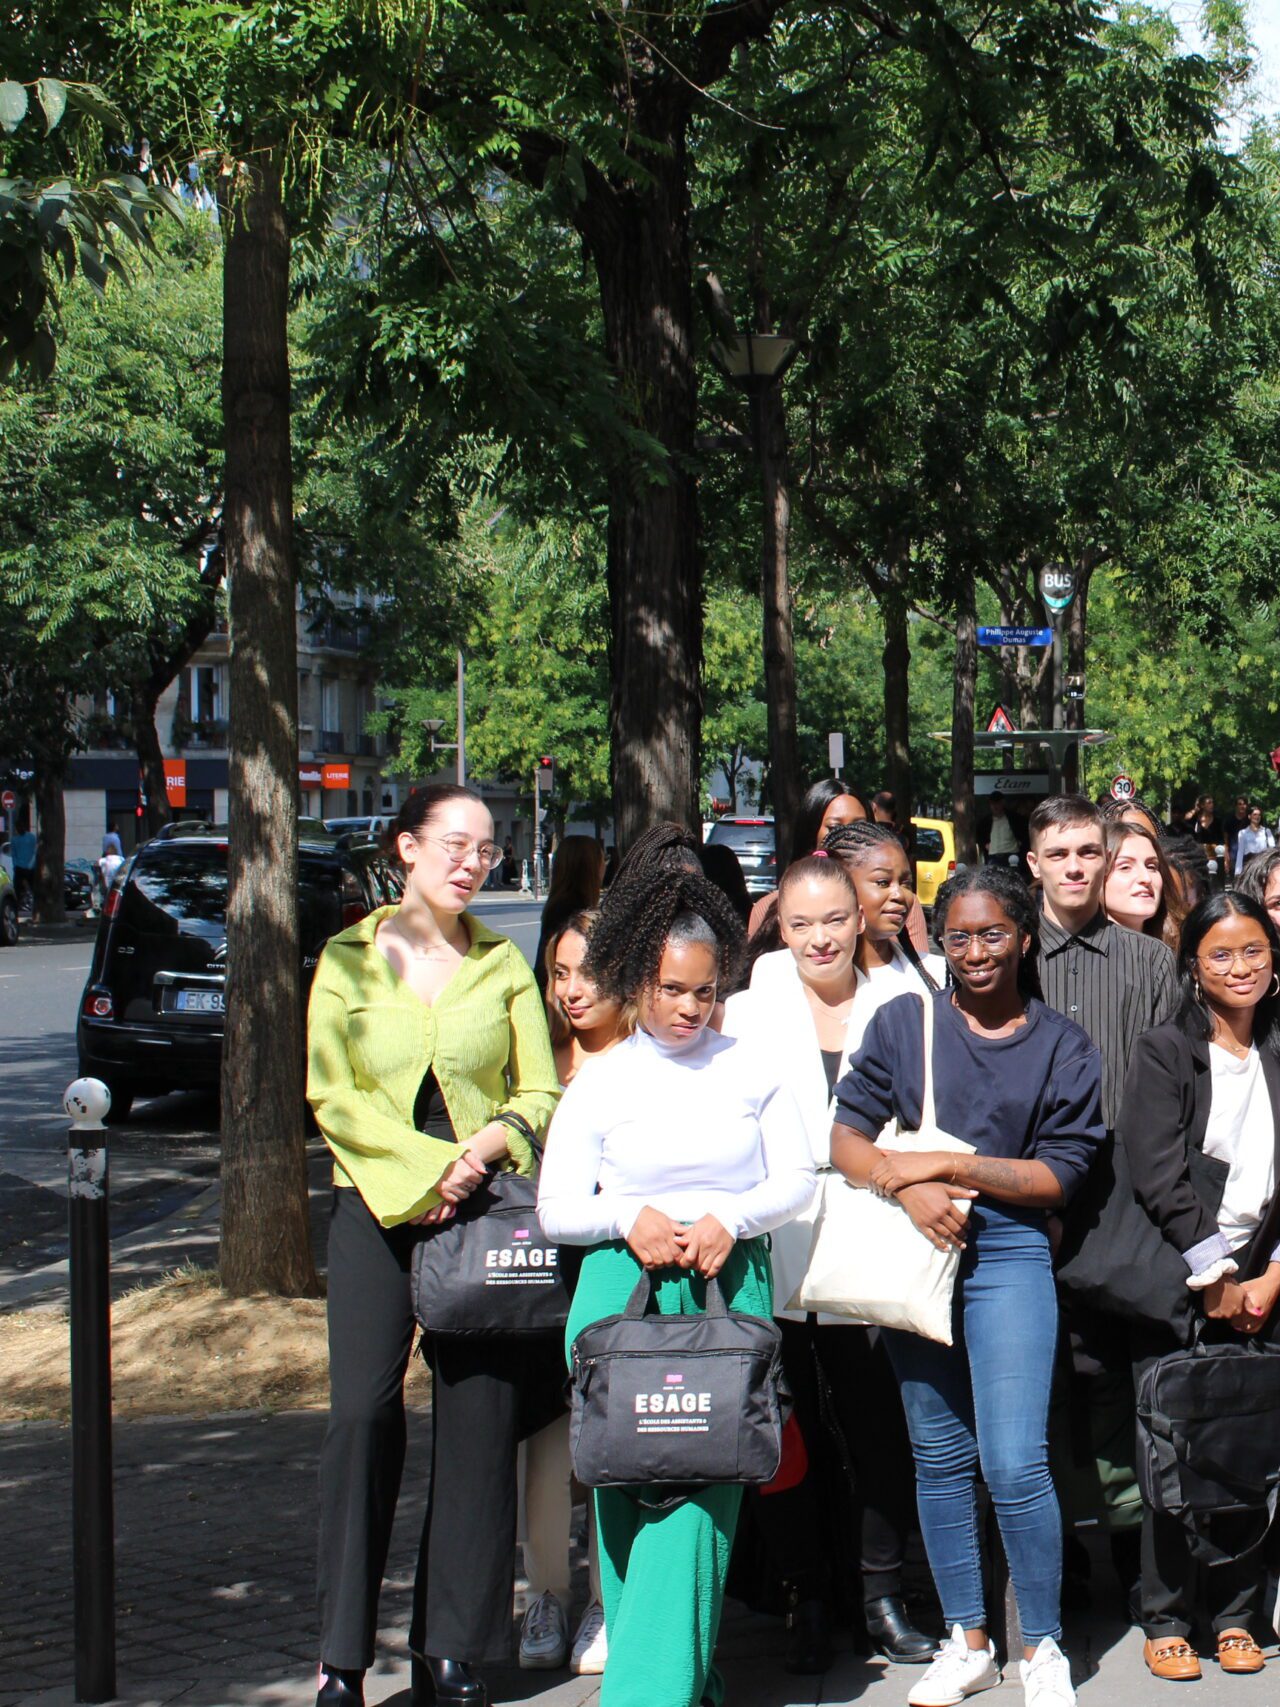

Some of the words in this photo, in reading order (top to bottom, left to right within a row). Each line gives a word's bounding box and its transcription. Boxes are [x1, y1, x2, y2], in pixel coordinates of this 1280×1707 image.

[1044, 573, 1072, 588] BUS
[985, 628, 1014, 637] Philippe
[1015, 628, 1043, 637] Auguste
[1067, 675, 1080, 686] 71
[166, 776, 186, 787] RIE
[993, 776, 1032, 790] Etam
[1116, 782, 1131, 794] 30
[485, 1248, 558, 1268] ESAGE
[635, 1393, 712, 1413] ESAGE
